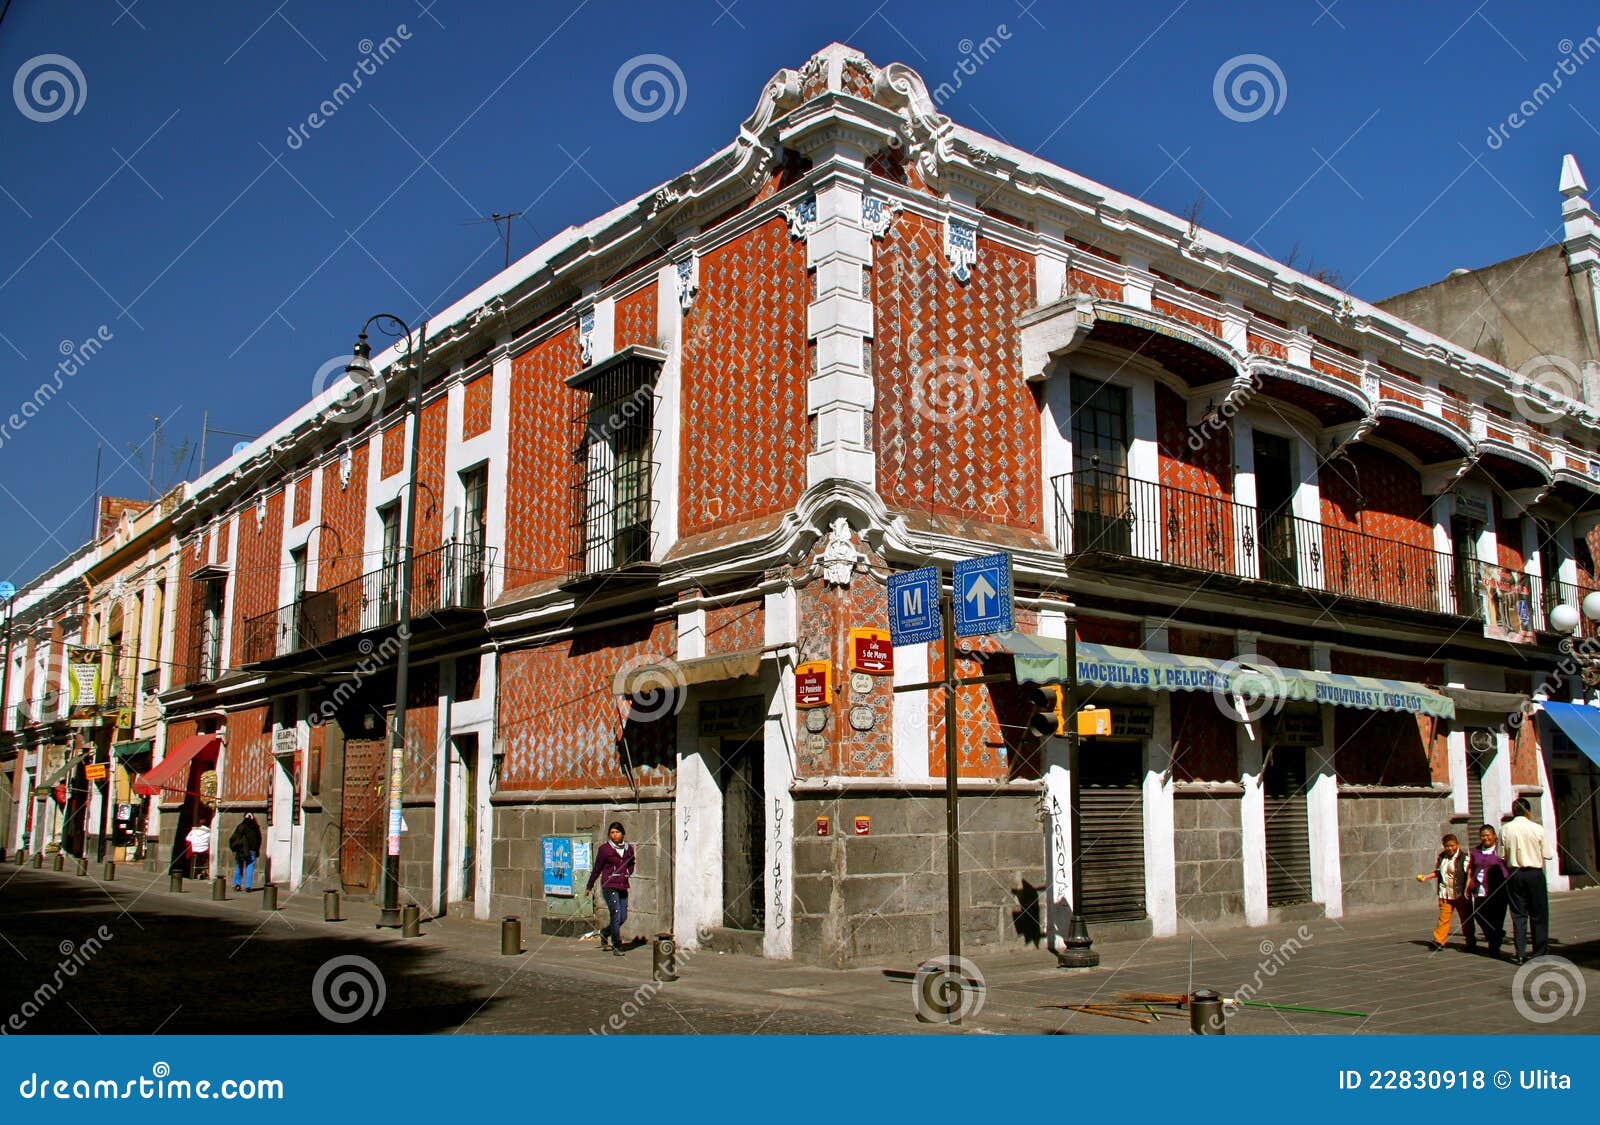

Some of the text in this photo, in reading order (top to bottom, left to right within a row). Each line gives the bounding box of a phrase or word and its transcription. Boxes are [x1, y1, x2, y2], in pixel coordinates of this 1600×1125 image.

[903, 587, 923, 617] M
[874, 652, 887, 661] Mayo
[1078, 661, 1231, 689] MOCHILAS Y PELUCHES
[805, 684, 823, 693] Poniente
[1315, 683, 1373, 706] ENVOLTURAS
[1374, 692, 1380, 705] Y
